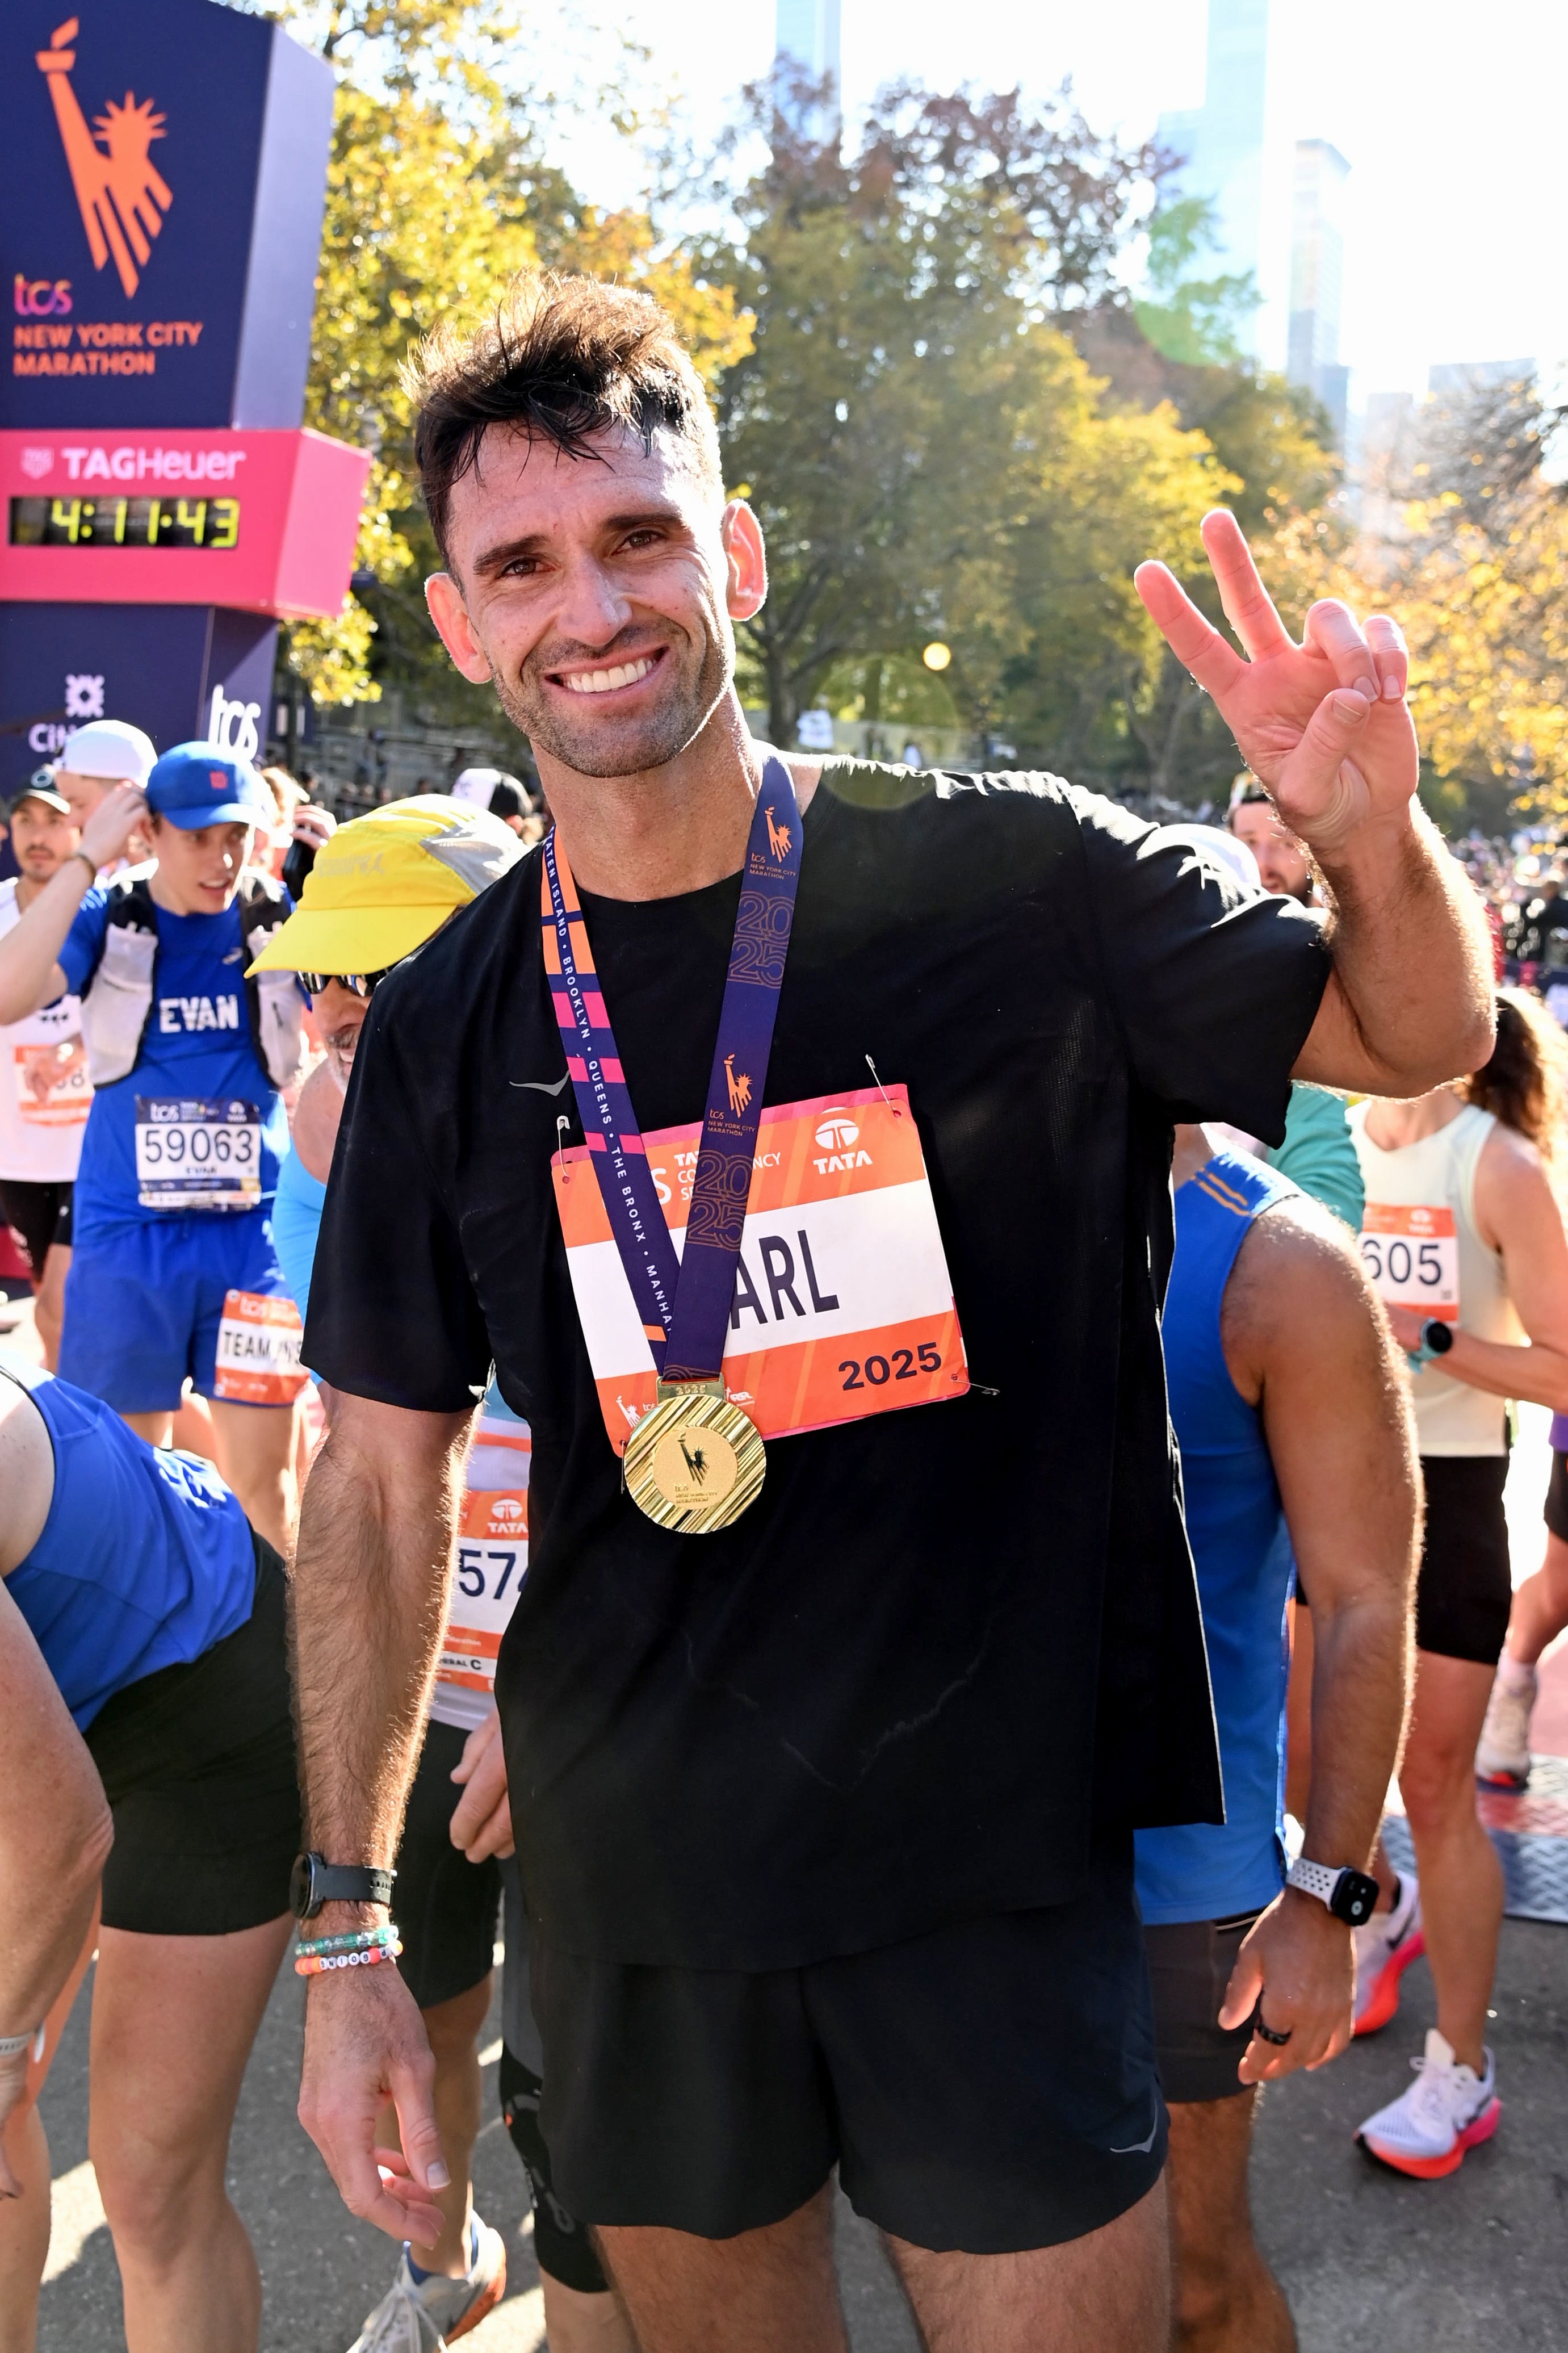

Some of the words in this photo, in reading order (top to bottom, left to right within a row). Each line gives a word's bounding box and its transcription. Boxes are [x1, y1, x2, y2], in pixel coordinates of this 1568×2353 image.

[14, 273, 73, 316] tcs
[14, 323, 73, 349] NEW
[77, 322, 143, 347] YORK
[146, 320, 203, 347] CITY
[13, 351, 156, 376] MARATHON
[751, 852, 766, 863] tcs
[749, 869, 785, 880] MARATHON
[160, 995, 239, 1033] EVAN
[545, 826, 556, 878] STATEN
[551, 883, 567, 936] ISLAND
[563, 956, 590, 1039] BROOKLYN
[589, 1061, 612, 1124] QUEENS
[611, 1146, 627, 1179] THE
[622, 1186, 646, 1242] BRONX
[710, 1108, 724, 1120] tcs
[707, 1127, 743, 1136] MARATHON
[145, 1128, 252, 1163] 59063
[812, 1150, 873, 1175] TATA
[731, 1230, 840, 1330] ARL
[224, 1332, 270, 1358] TEAM
[838, 1342, 942, 1391] 2025
[488, 1522, 529, 1533] TATA
[321, 1954, 369, 1968] GOING
